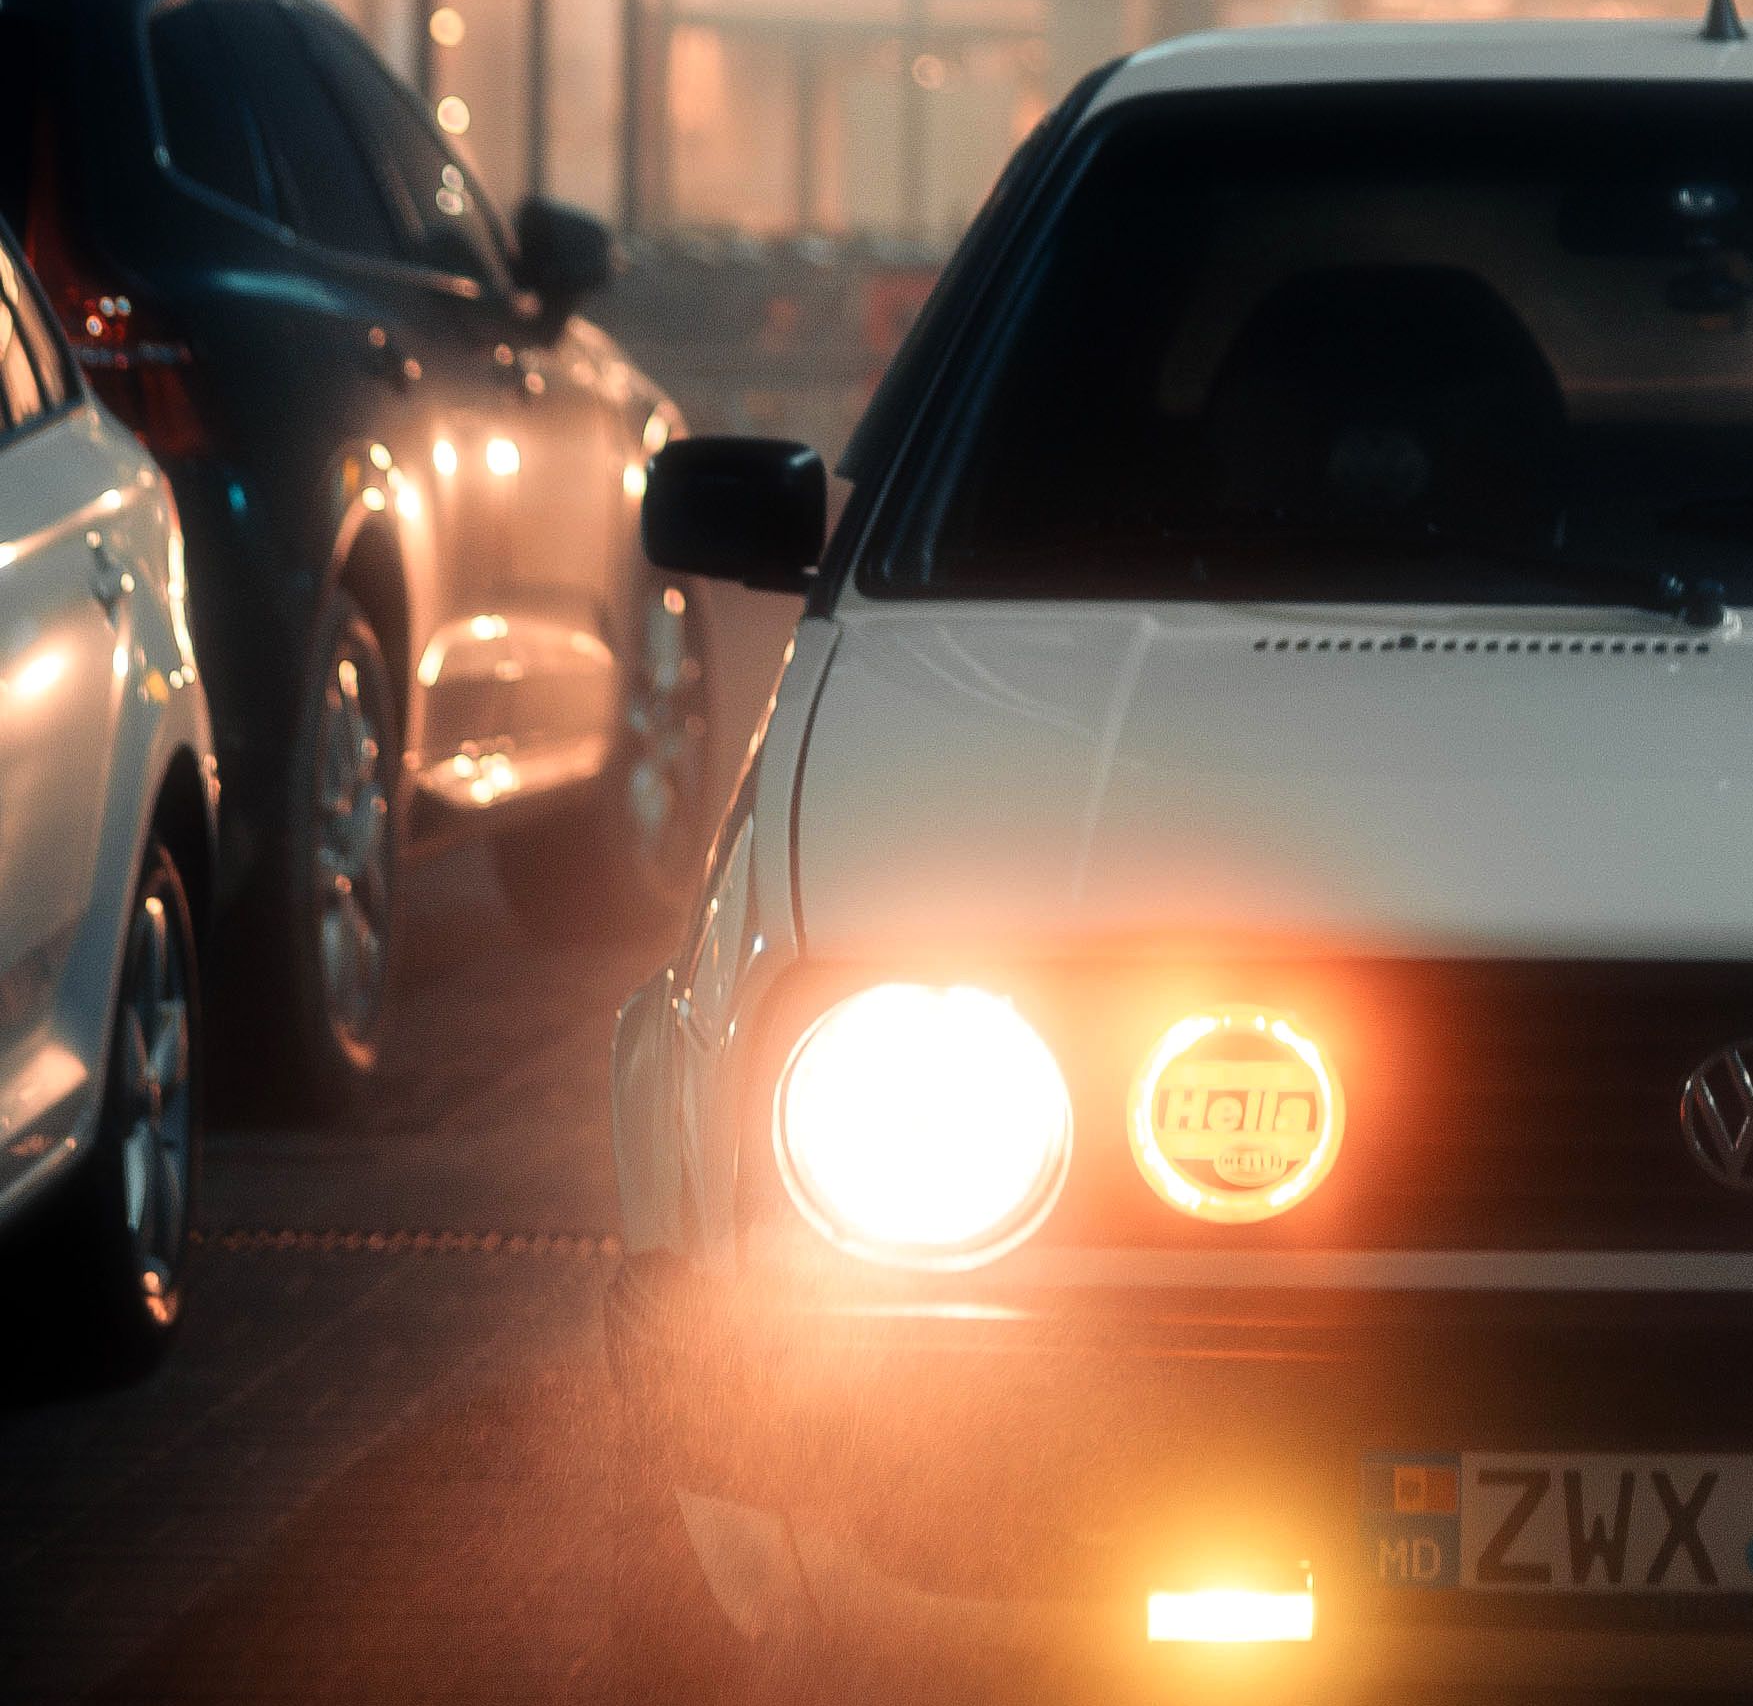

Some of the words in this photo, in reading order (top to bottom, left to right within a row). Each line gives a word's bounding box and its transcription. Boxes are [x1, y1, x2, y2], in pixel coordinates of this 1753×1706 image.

[1162, 1090, 1310, 1132] Hella
[1474, 1469, 1720, 1585] ZWX
[1378, 1537, 1442, 1577] MD
